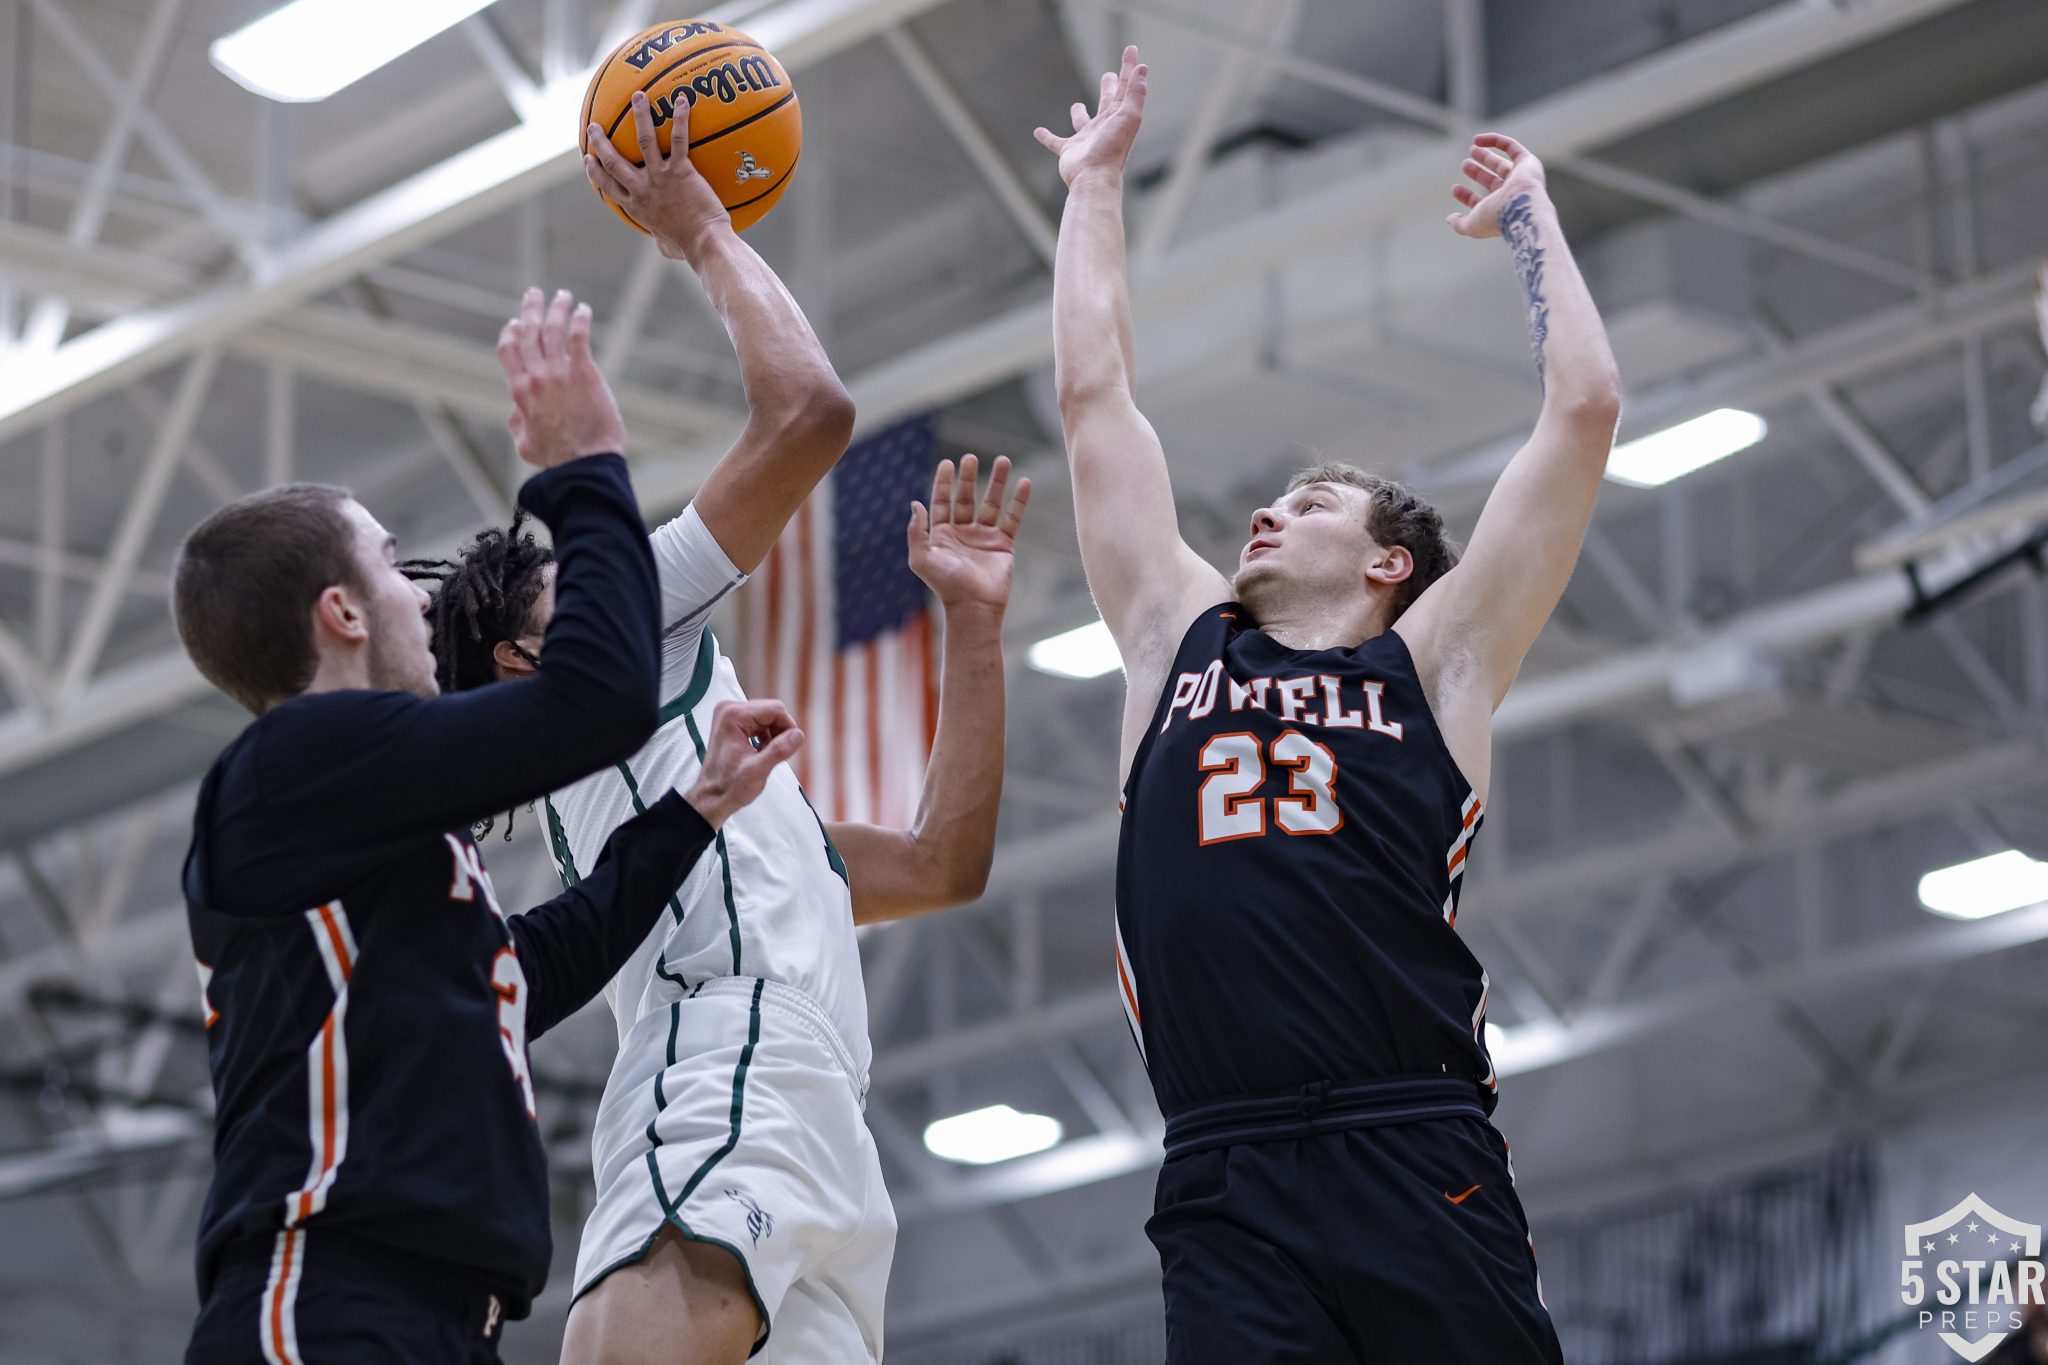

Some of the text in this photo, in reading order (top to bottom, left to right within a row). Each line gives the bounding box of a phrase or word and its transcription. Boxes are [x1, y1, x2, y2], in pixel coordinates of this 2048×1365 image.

[624, 22, 724, 71] NCAA
[650, 54, 781, 129] Wilson
[1159, 658, 1404, 742] POWELL
[1198, 728, 1344, 847] 23
